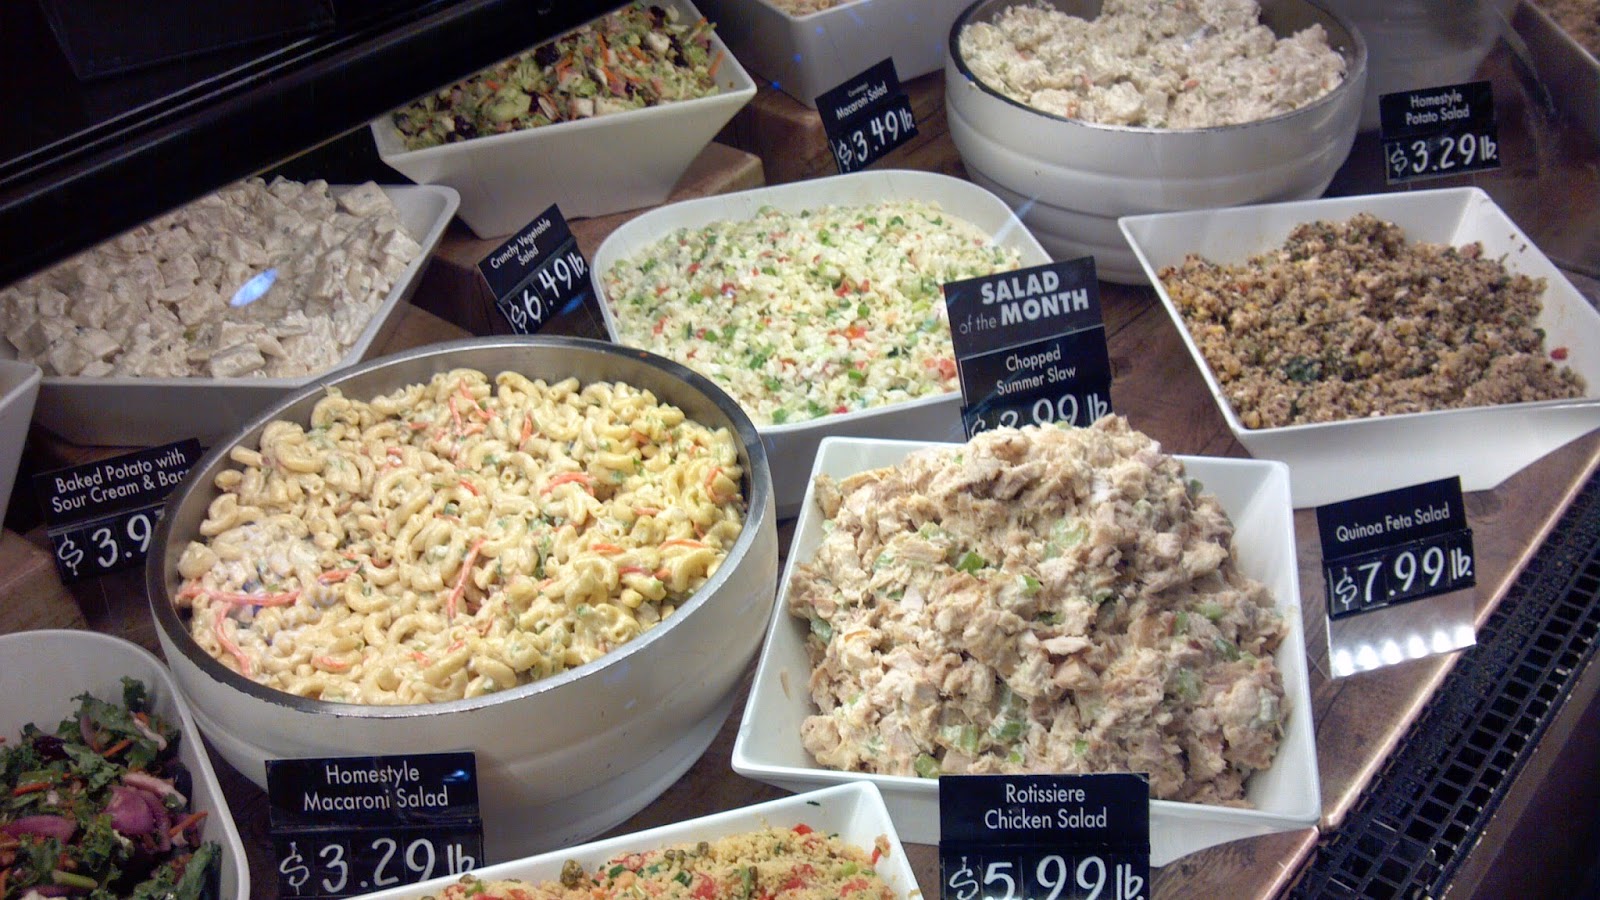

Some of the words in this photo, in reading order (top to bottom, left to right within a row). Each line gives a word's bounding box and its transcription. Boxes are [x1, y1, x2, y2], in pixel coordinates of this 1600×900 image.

[836, 93, 869, 120] Macaroni
[867, 80, 888, 101] Salad
[1405, 111, 1438, 125] Potato
[1440, 103, 1470, 120] Salad
[1410, 88, 1463, 108] Homestyle
[1390, 133, 1476, 177] $3.29
[490, 243, 519, 269] Crunchy
[518, 217, 552, 247] Vegetable
[517, 243, 539, 266] Salad
[980, 270, 1060, 305] SALAD
[959, 314, 973, 335] of
[976, 312, 997, 331] the
[1001, 288, 1090, 326] MONTH
[1006, 343, 1062, 372] Chopped
[996, 373, 1045, 396] Summer
[1047, 366, 1077, 383] Slaw
[55, 467, 103, 494] Baked
[105, 459, 153, 482] Potato
[155, 447, 186, 469] with
[52, 494, 87, 513] Sour
[90, 482, 140, 503] Cream
[143, 474, 156, 491] &
[157, 469, 190, 487] Bac
[1336, 522, 1383, 542] Quinoa
[1385, 514, 1412, 532] Feta
[1414, 501, 1450, 526] Salad
[58, 508, 165, 576] $3.9
[1335, 547, 1444, 611] $7.99
[326, 760, 420, 788] Homestyle
[1006, 783, 1086, 804] Rotissiere
[303, 789, 390, 811] Macaroni
[397, 785, 449, 808] Salad
[985, 808, 1052, 829] Chicken
[1057, 807, 1107, 828] Salad
[279, 838, 436, 896] $3.29
[949, 855, 1106, 900] $599
